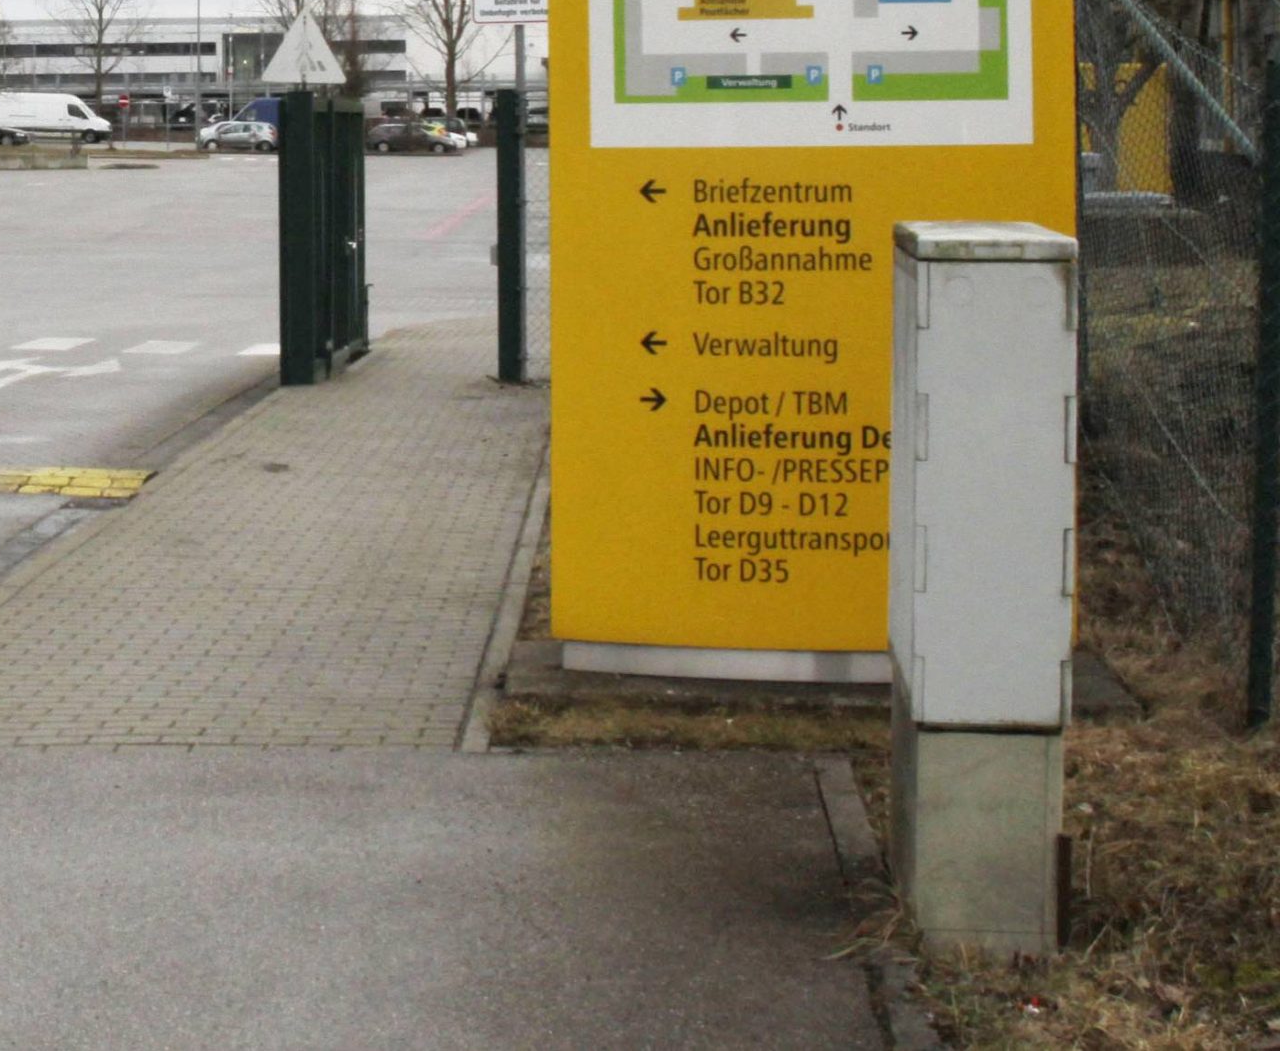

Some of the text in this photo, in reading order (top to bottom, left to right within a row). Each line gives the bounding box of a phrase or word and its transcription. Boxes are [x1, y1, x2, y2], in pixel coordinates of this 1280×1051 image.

[721, 76, 778, 89] Verwaltung
[847, 122, 891, 132] Standort
[693, 177, 853, 204] Briefzentrum
[693, 211, 851, 244] Anlieferung
[693, 246, 873, 272] Großannahme
[693, 280, 785, 306] Tor B32
[693, 332, 839, 364] Verwaltung
[694, 389, 848, 422] Depot / TBM
[694, 423, 852, 457] Anlieferung
[695, 456, 765, 483] INFO-
[694, 490, 732, 515] Tor
[739, 491, 773, 516] D9
[799, 491, 848, 517] D12
[694, 557, 789, 584] Tor D35
